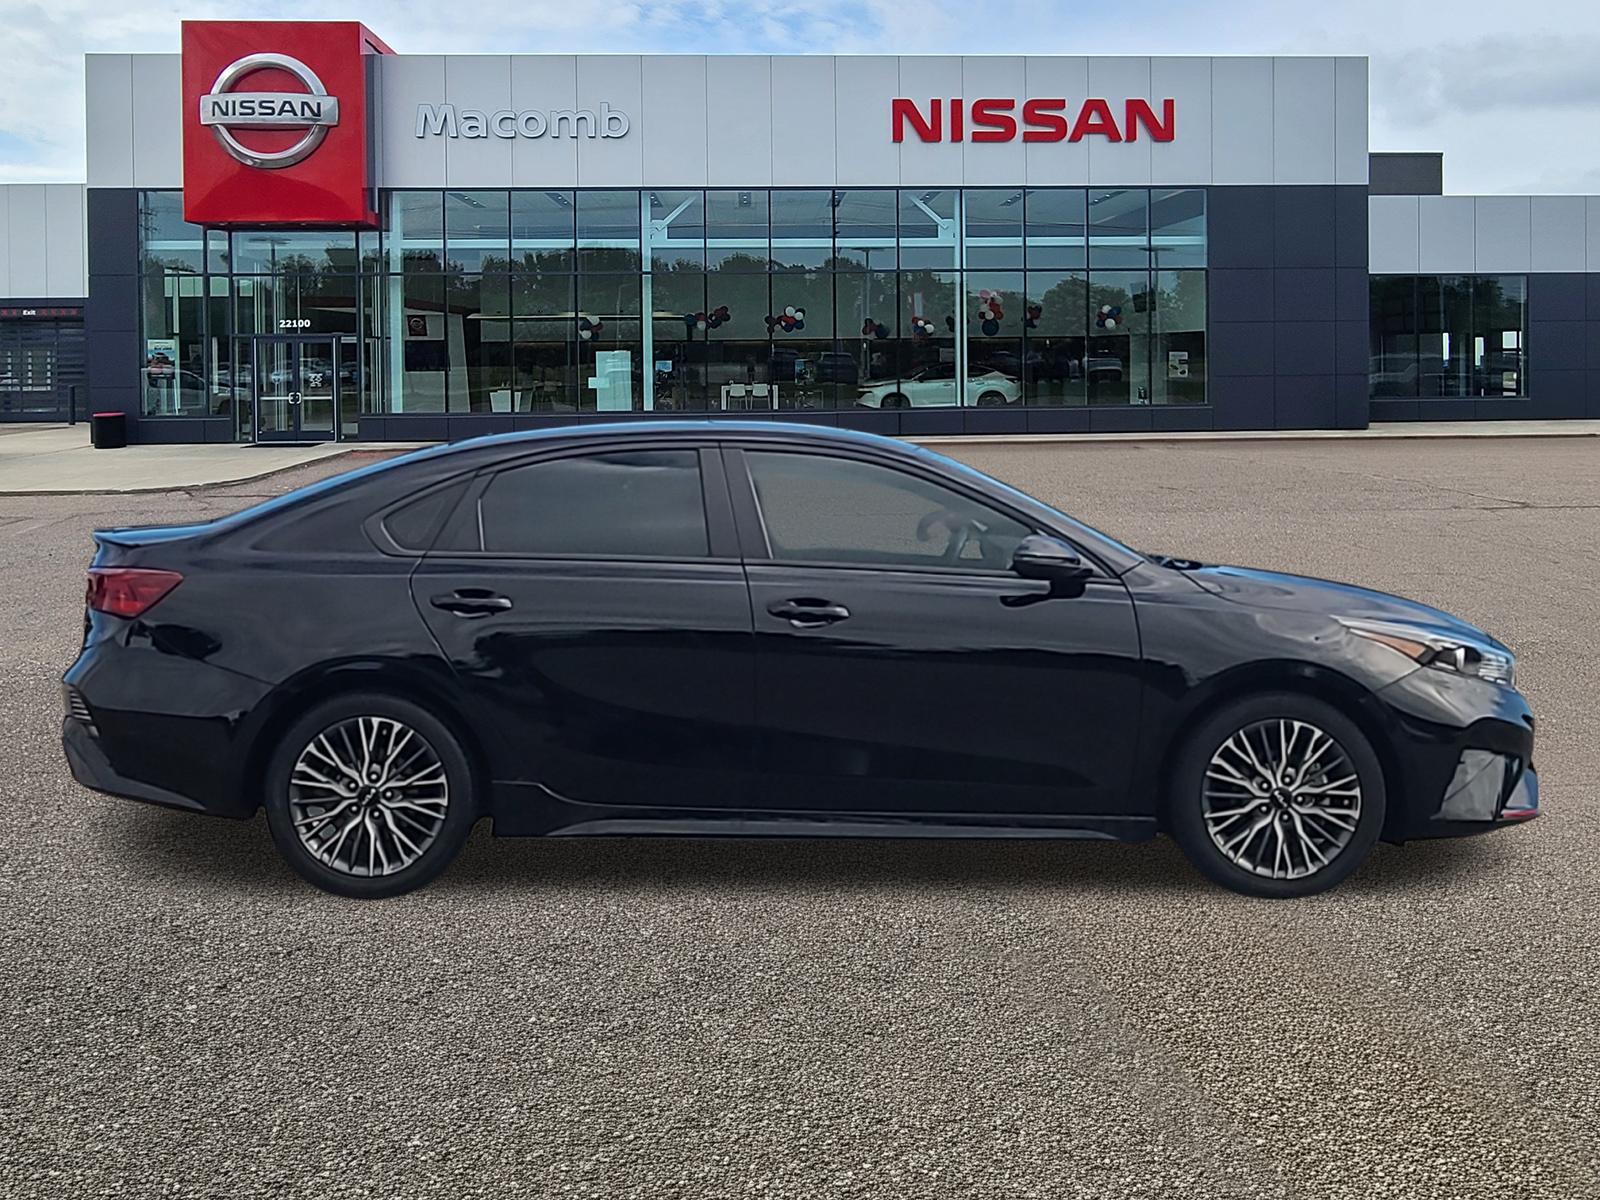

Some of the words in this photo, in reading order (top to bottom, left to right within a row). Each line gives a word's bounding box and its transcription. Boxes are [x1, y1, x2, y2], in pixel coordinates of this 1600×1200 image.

[211, 100, 322, 118] NISSAN
[415, 101, 630, 139] Macomb
[892, 98, 1175, 143] NISSAN
[279, 319, 311, 328] 22100
